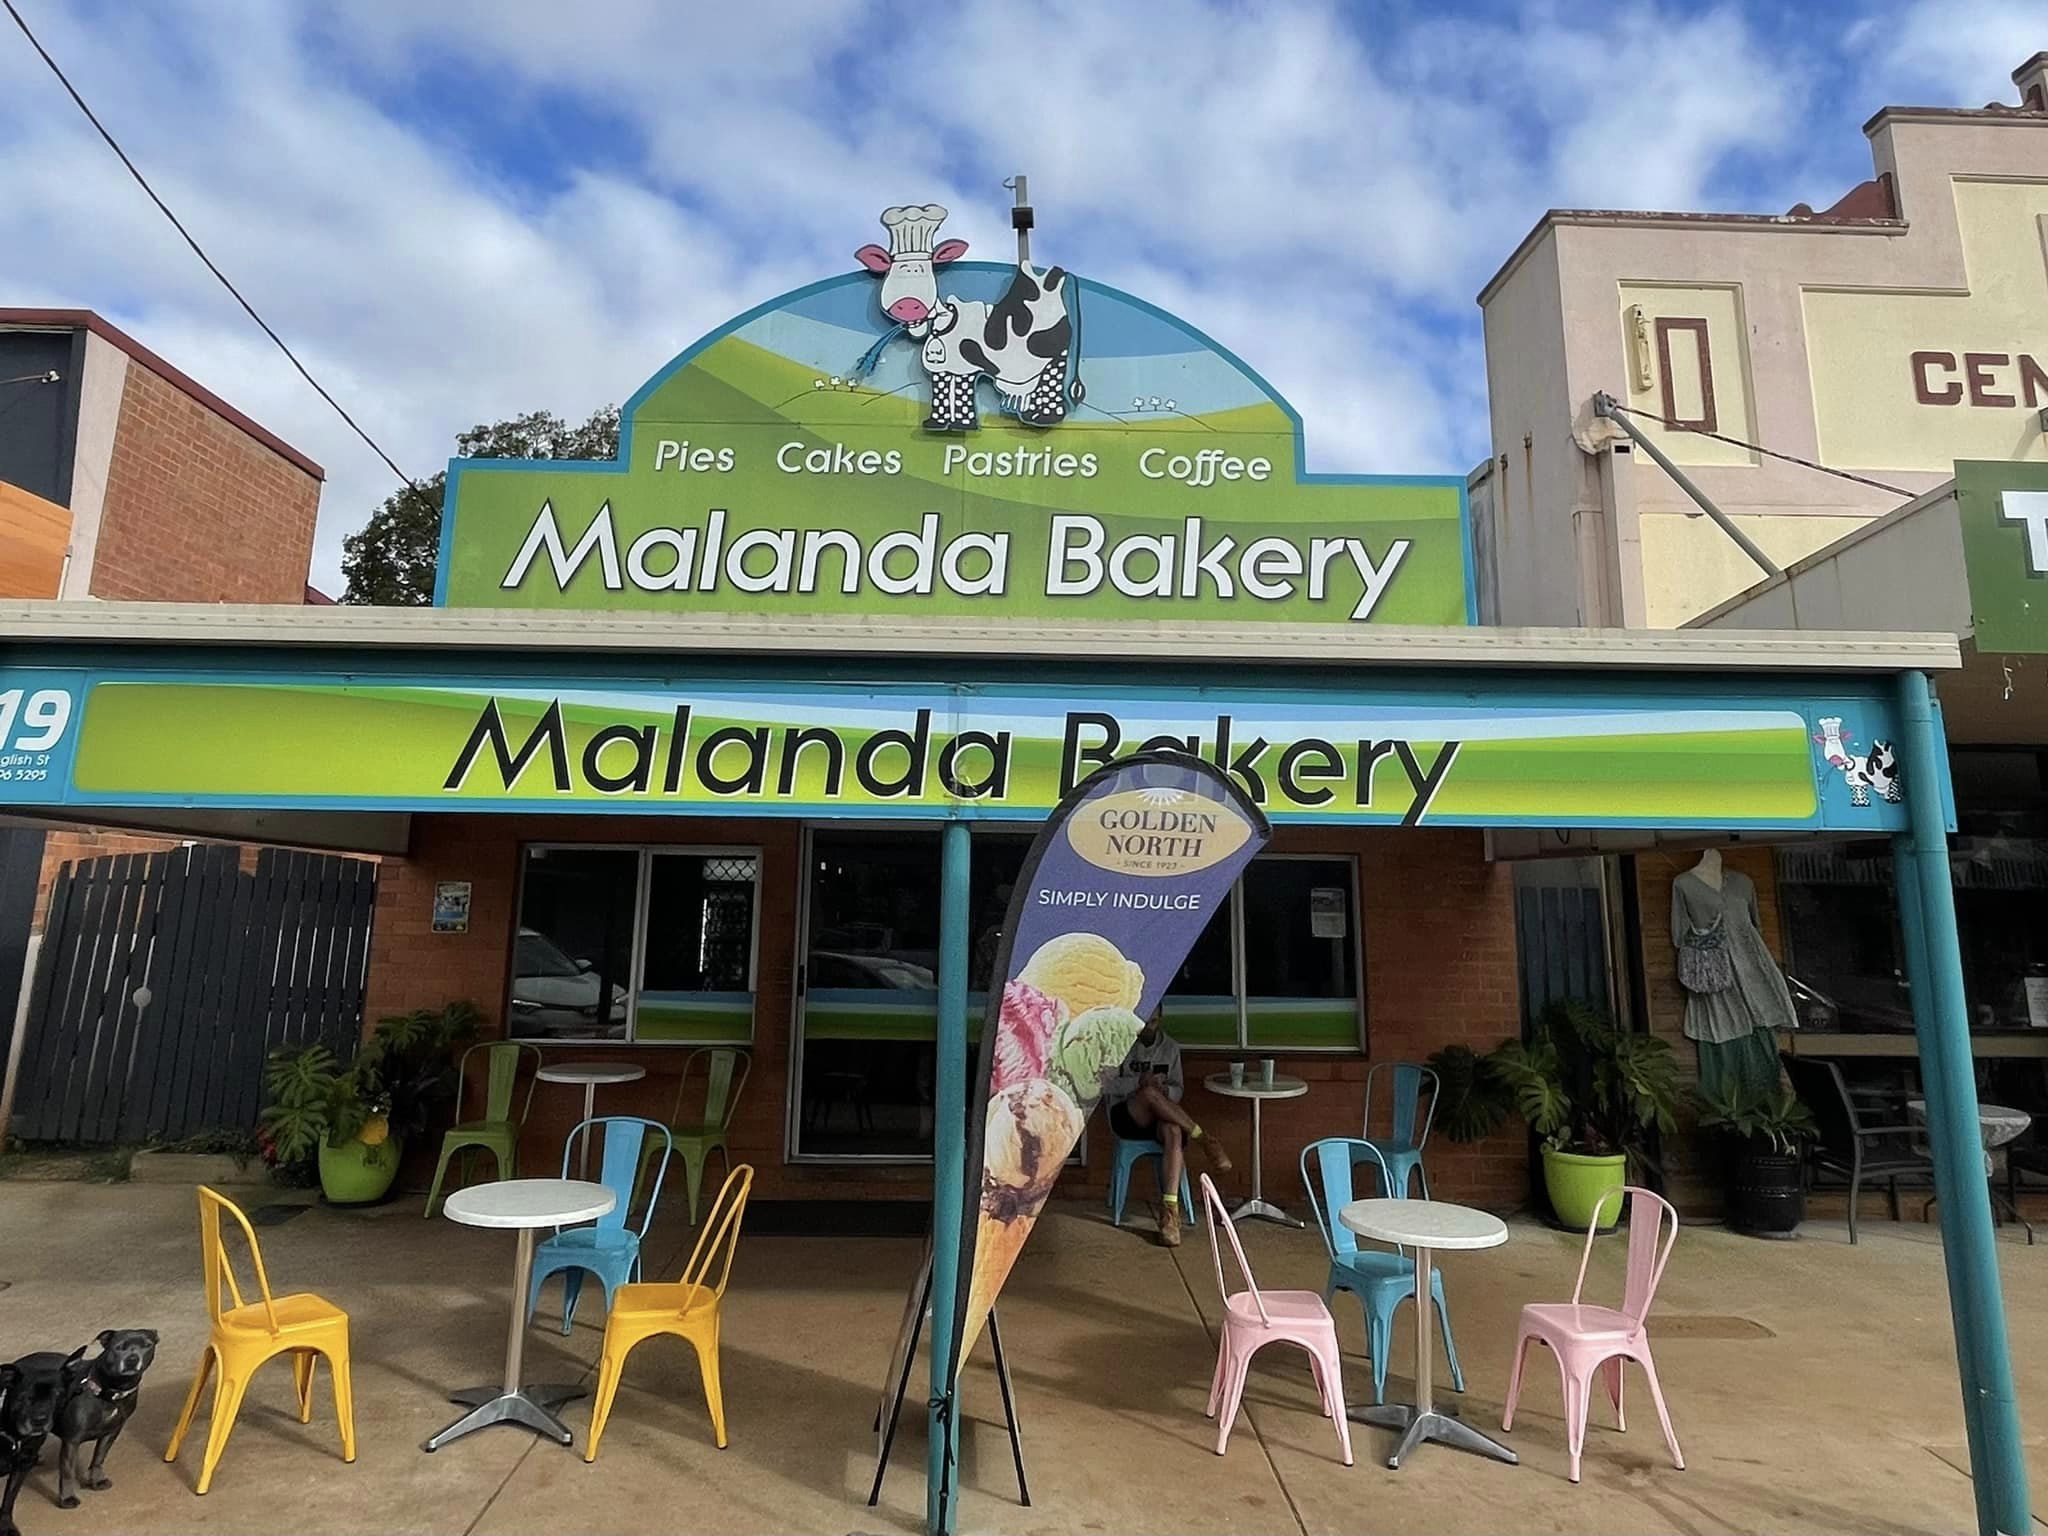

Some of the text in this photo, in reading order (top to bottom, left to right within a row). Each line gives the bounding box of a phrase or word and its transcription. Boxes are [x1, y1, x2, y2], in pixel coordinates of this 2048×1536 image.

[654, 440, 1272, 487] Pies Cakes Pastries Coffee
[500, 498, 1414, 621] Malanda Bakery
[0, 689, 72, 752] 19
[443, 696, 1011, 799] Malanda
[36, 754, 51, 767] St
[15, 769, 48, 781] 5295
[1099, 808, 1218, 834] GOLDEN
[1105, 834, 1203, 859] NORTH
[1123, 860, 1152, 869] SINCE
[1038, 889, 1201, 911] SIMPLY INDULGE
